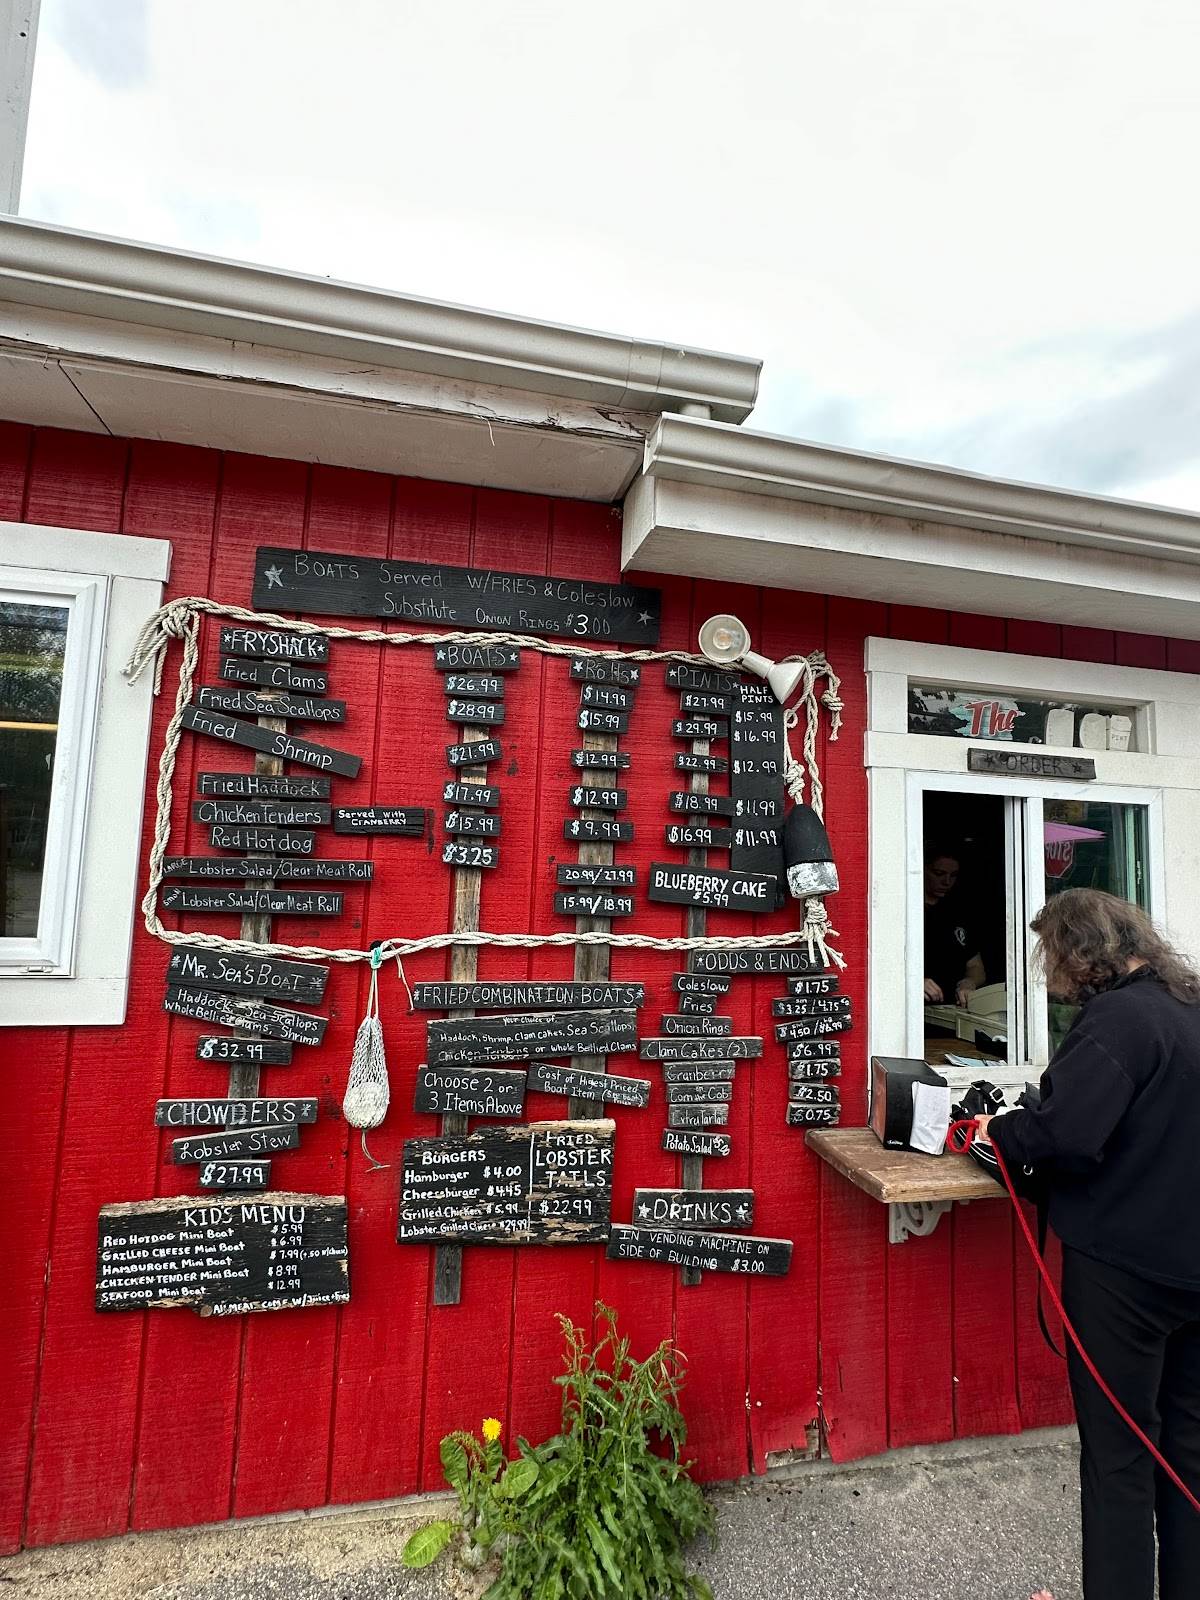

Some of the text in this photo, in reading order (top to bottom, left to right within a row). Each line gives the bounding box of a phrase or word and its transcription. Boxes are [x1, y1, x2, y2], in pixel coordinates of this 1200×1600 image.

[295, 553, 635, 608] BOATS Served W/FRIES & Coleslaw
[383, 591, 457, 621] Substitute
[565, 613, 611, 635] $3.00
[231, 630, 317, 657] FRYSHACK
[447, 645, 506, 668] BOATS
[224, 659, 326, 690] Fried Clams
[677, 665, 735, 691] PINTS
[447, 676, 498, 692] $26.99
[740, 685, 768, 695] HALF
[200, 688, 340, 721] Fried Sea Scallops
[583, 685, 626, 706] $14.99
[685, 695, 725, 709] $27.99
[741, 694, 774, 703] PINTS
[448, 700, 495, 719] $28.99
[735, 710, 773, 723] $15.99
[579, 710, 620, 728] $15.99
[676, 722, 717, 734] $29.99
[191, 710, 333, 769] Fried Shrimp
[733, 730, 776, 743] $16.99
[449, 742, 495, 764] $21.99
[575, 751, 617, 767] $12.99
[678, 755, 716, 770] $22.99
[733, 760, 777, 774] $12.99
[1006, 755, 1060, 775] ORDER
[202, 775, 321, 796] Fried Haddock
[443, 782, 491, 802] $17.99
[573, 787, 618, 805] $12.99
[674, 791, 718, 811] $18.99
[199, 802, 321, 824] Chicken Tenders
[338, 809, 376, 818] Served
[735, 799, 775, 816] $11.99
[445, 811, 493, 831] $15.99
[570, 820, 621, 837] $9.99
[211, 827, 240, 847] Red
[668, 826, 712, 844] $16.99
[735, 829, 777, 847] $11.99
[442, 843, 492, 865] $3.25
[189, 860, 237, 875] Lobster
[316, 864, 346, 877] Meat
[349, 863, 371, 878] Roll
[655, 871, 767, 897] BLUEBERRY CAKE
[182, 892, 225, 907] Lobster
[287, 895, 313, 911] Meat
[318, 896, 340, 912] Roll
[563, 895, 632, 914] 15.99/18.99
[692, 891, 729, 906] $5.99
[705, 952, 808, 970] ODDS & ENDS
[256, 964, 305, 990] BOAT
[677, 976, 729, 991] Coleslaw
[423, 986, 635, 1004] FRIED COMBINATION BOATS
[795, 980, 829, 994] $1.75
[683, 996, 713, 1013] Fries
[514, 1024, 588, 1041] Clam Sea
[666, 1018, 730, 1035] Onion Rings
[200, 1039, 263, 1060] $32.99
[610, 1041, 637, 1051] Clams
[646, 1041, 748, 1058] Clam Cakes (2)
[793, 1043, 831, 1058] $6.99
[424, 1072, 513, 1093] Choose 2 or
[565, 1072, 576, 1083] of
[428, 1091, 522, 1114] 3 Items Above
[795, 1086, 832, 1102] $2.50
[167, 1101, 297, 1125] CHOWDERS
[792, 1109, 831, 1123] $0.75
[180, 1132, 291, 1160] Lobster Stew
[666, 1133, 690, 1151] Potato
[421, 1149, 486, 1165] BURGERS
[535, 1148, 612, 1167] LOBSTER
[200, 1163, 263, 1185] $27.99
[404, 1165, 522, 1184] Hamburger $4.00
[486, 1184, 522, 1197] $4.45
[241, 1204, 305, 1224] MENU
[402, 1206, 443, 1220] Grilled
[538, 1199, 592, 1216] $22.99
[653, 1198, 732, 1223] DRINKS
[179, 1231, 204, 1241] Mini
[206, 1228, 234, 1239] Boat
[400, 1225, 437, 1238] Lobster
[152, 1247, 191, 1258] CHEESE
[194, 1244, 217, 1254] Mini
[219, 1241, 245, 1252] Boat
[618, 1230, 770, 1255] IN VENDING MACHINE ON
[181, 1259, 204, 1268] Mini
[206, 1256, 233, 1267] Boat
[618, 1243, 765, 1273] SIDE OF BUILDING $3.00
[101, 1276, 156, 1289] CHICKEN
[156, 1272, 198, 1284] TENDER
[200, 1270, 222, 1280] Mini
[223, 1268, 250, 1278] Boat
[101, 1289, 153, 1303] SEAFOOD
[159, 1287, 179, 1297] Mini
[181, 1286, 206, 1296] Boat
